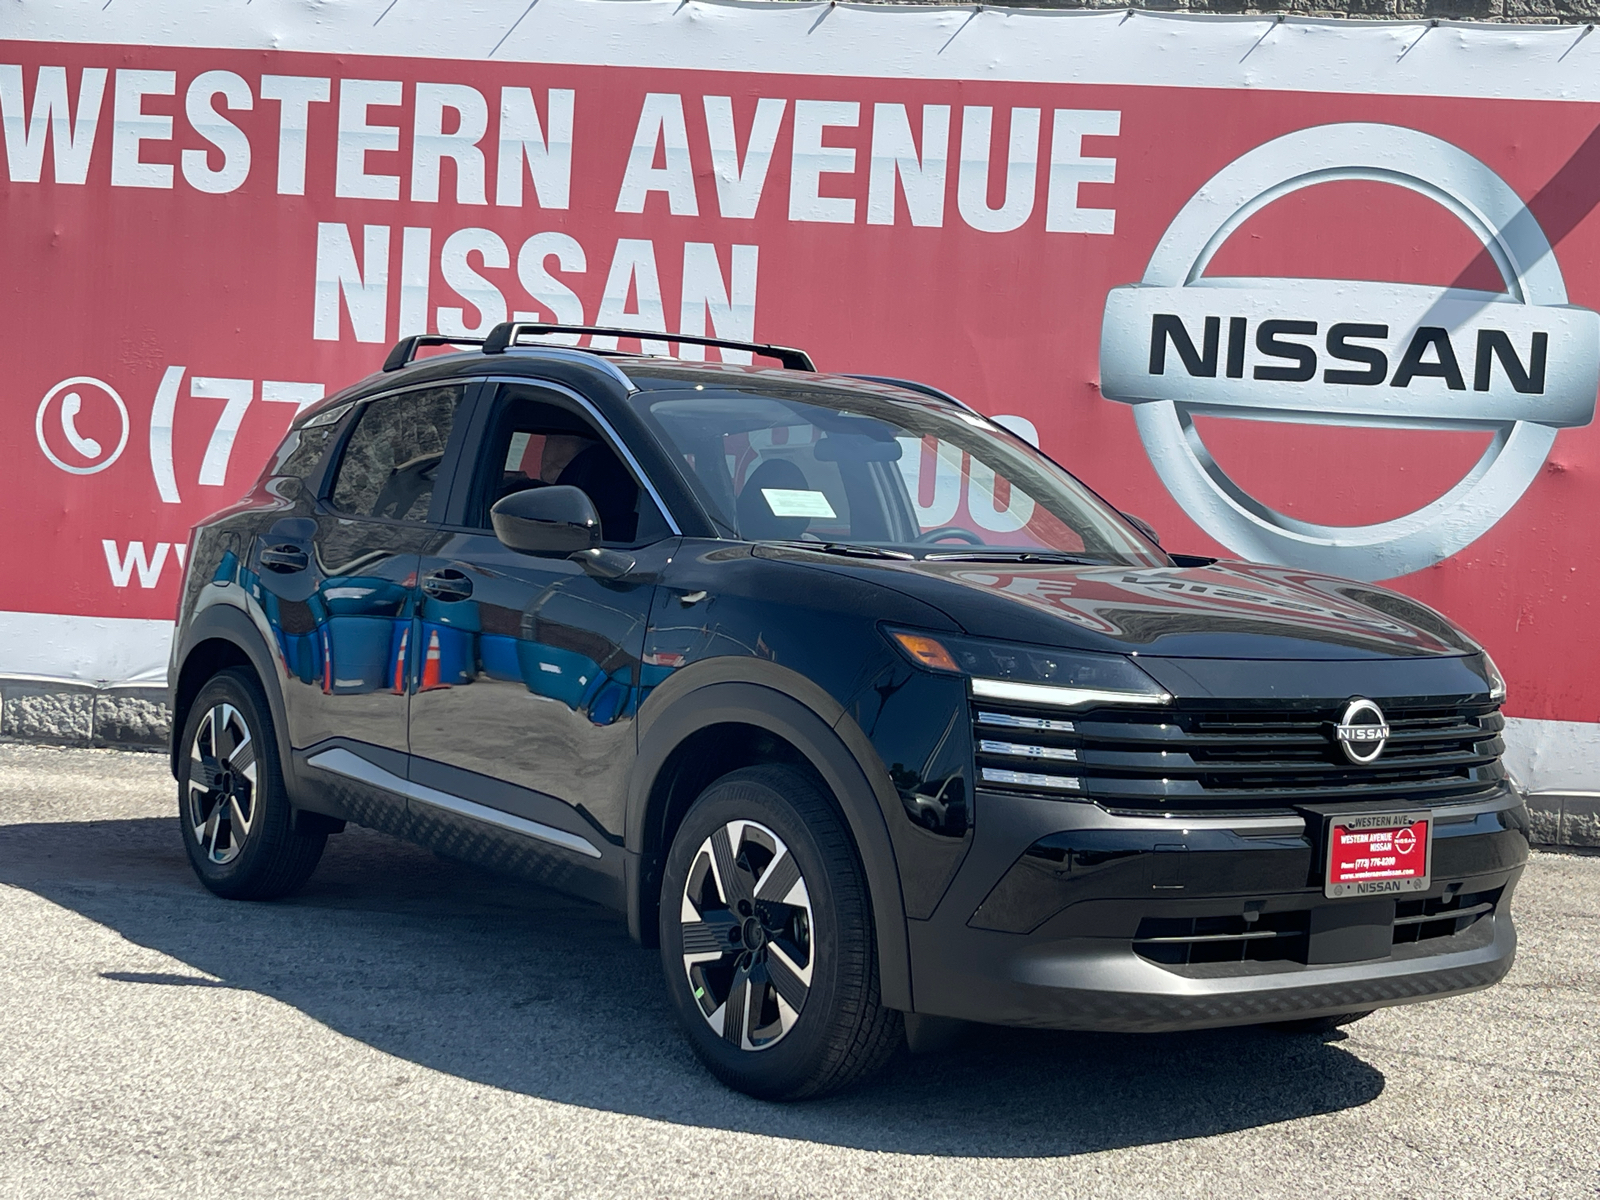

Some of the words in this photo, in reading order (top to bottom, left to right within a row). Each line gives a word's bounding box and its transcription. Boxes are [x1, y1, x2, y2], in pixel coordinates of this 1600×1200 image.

[0, 64, 576, 210] WESTERN
[615, 92, 1122, 235] AVENUE
[313, 222, 760, 366] NISSAN
[1149, 313, 1549, 395] NISSAN
[1339, 727, 1390, 740] NISSAN
[1355, 816, 1391, 828] WESTERN
[1341, 834, 1369, 845] WESTERN
[1369, 832, 1394, 843] AVENUE
[1370, 842, 1392, 852] NISSAN
[1357, 880, 1401, 894] NISSAN
